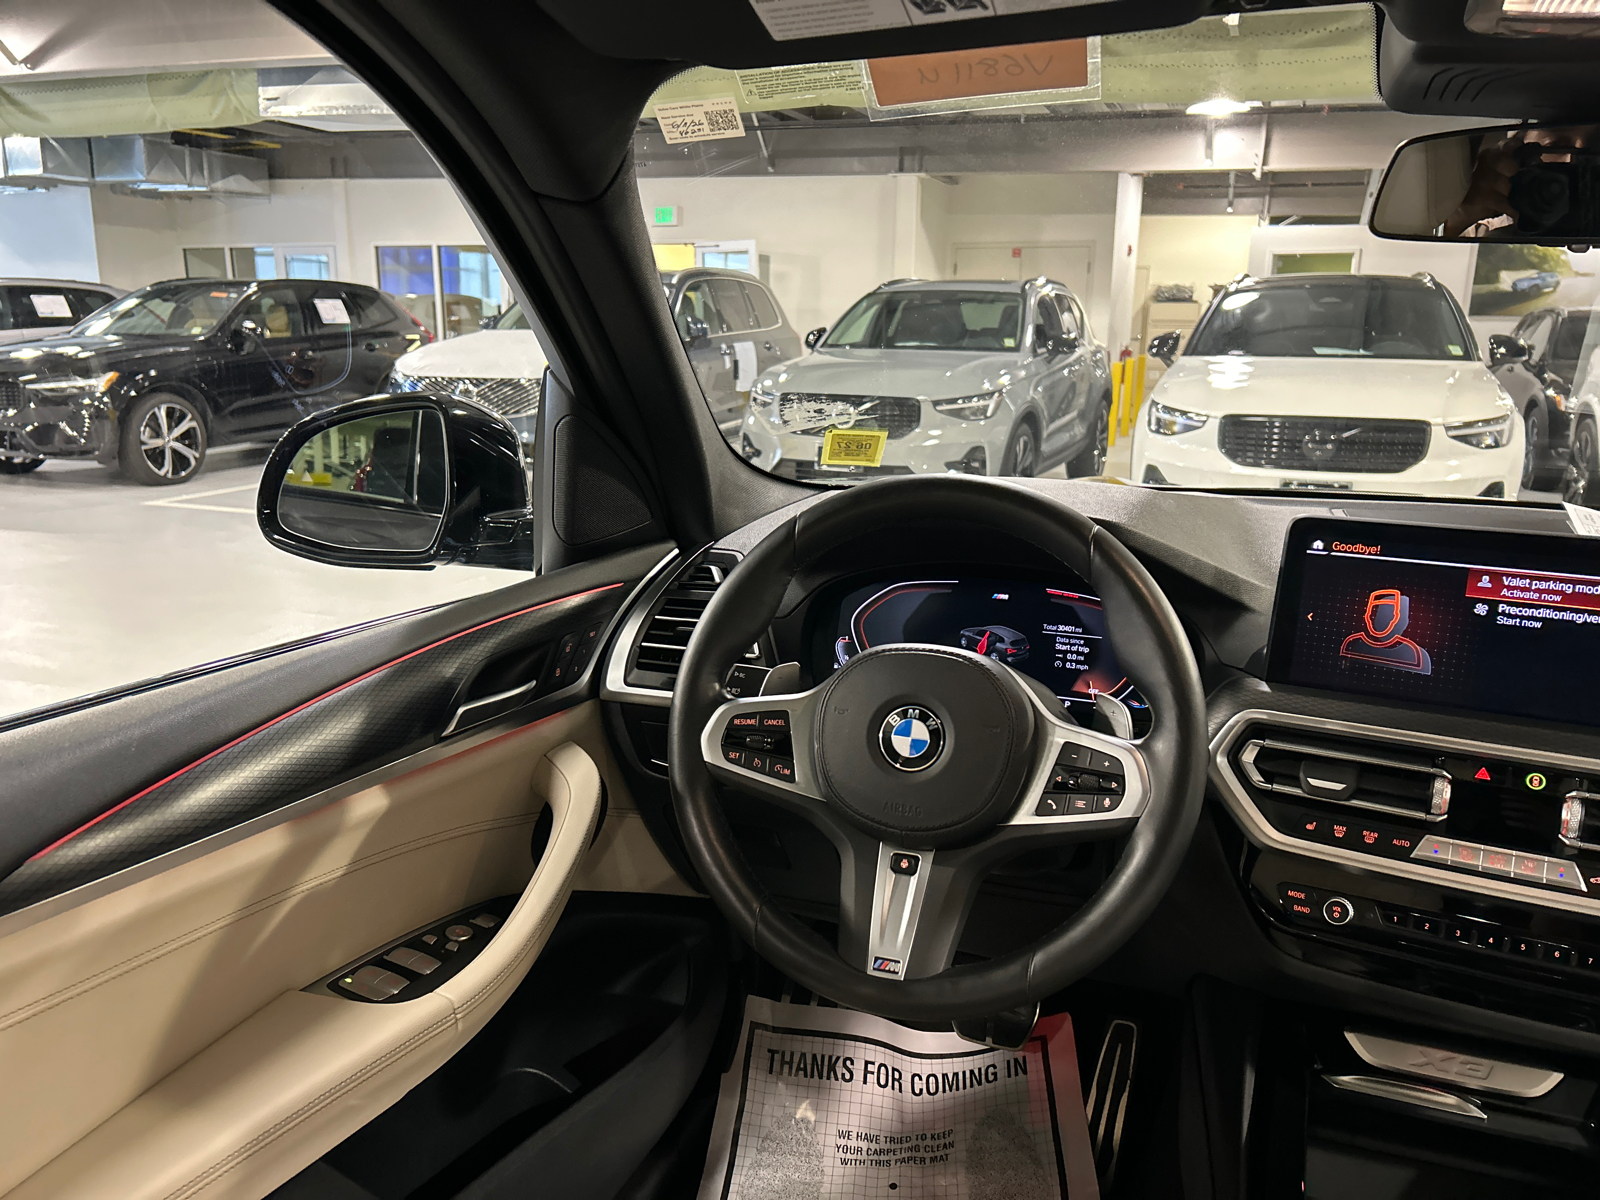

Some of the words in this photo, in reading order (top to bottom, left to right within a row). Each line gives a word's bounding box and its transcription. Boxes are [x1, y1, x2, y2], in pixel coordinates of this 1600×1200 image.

[1332, 541, 1381, 555] Goodbye!
[1502, 576, 1530, 588] Valet
[1531, 580, 1573, 594] parking
[1500, 588, 1540, 599] Activate
[1541, 594, 1562, 602] now
[1057, 624, 1075, 632] 30401
[1496, 615, 1521, 626] Start
[1521, 620, 1542, 628] now
[1078, 645, 1090, 653] trip
[888, 708, 938, 731] BMW
[728, 751, 740, 759] SET
[1333, 824, 1347, 832] MAX
[1362, 830, 1378, 838] REAR
[1392, 838, 1411, 848] AUTO
[1288, 890, 1306, 900] MODE
[1293, 904, 1311, 914] BAND
[1455, 929, 1461, 937] 3
[1409, 1049, 1494, 1081] X3
[767, 1048, 855, 1083] THANKS
[863, 1060, 903, 1093] FOR
[911, 1064, 998, 1097] COMING
[1006, 1056, 1028, 1078] IN
[838, 1129, 853, 1140] WE
[856, 1131, 880, 1144] HAVE
[883, 1135, 912, 1145] TRIED
[915, 1133, 927, 1142] TO
[930, 1129, 954, 1141] KEEP
[836, 1144, 863, 1156] YOUR
[866, 1144, 921, 1156] CARPETING
[924, 1140, 954, 1153] CLEAN
[840, 1157, 866, 1166] WITH
[869, 1159, 892, 1167] THIS
[895, 1156, 926, 1166] PAPER
[929, 1153, 950, 1164] MAT
